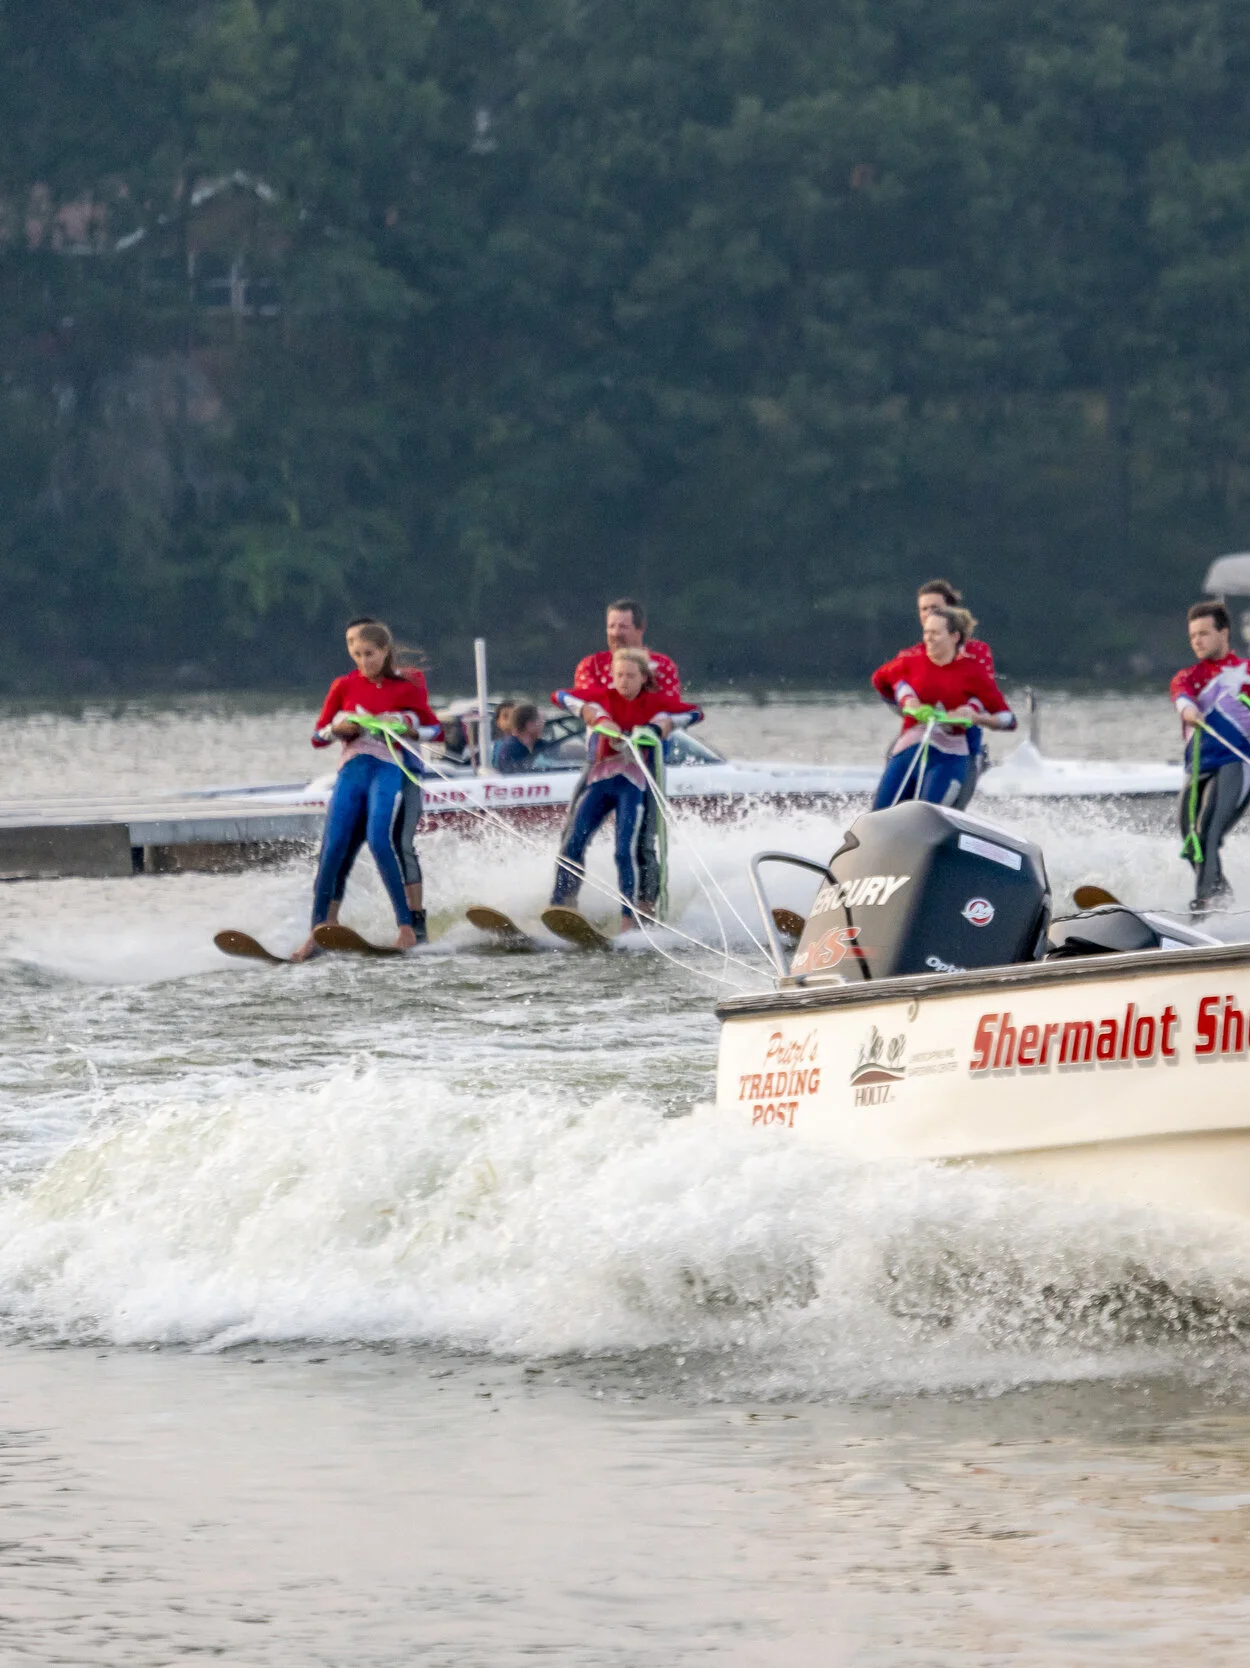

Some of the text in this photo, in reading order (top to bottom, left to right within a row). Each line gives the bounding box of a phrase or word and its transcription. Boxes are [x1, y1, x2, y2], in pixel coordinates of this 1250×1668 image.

[484, 784, 550, 800] Team
[969, 1001, 1179, 1071] Shermalot
[738, 1067, 821, 1101] TRADING
[751, 1101, 799, 1128] POST
